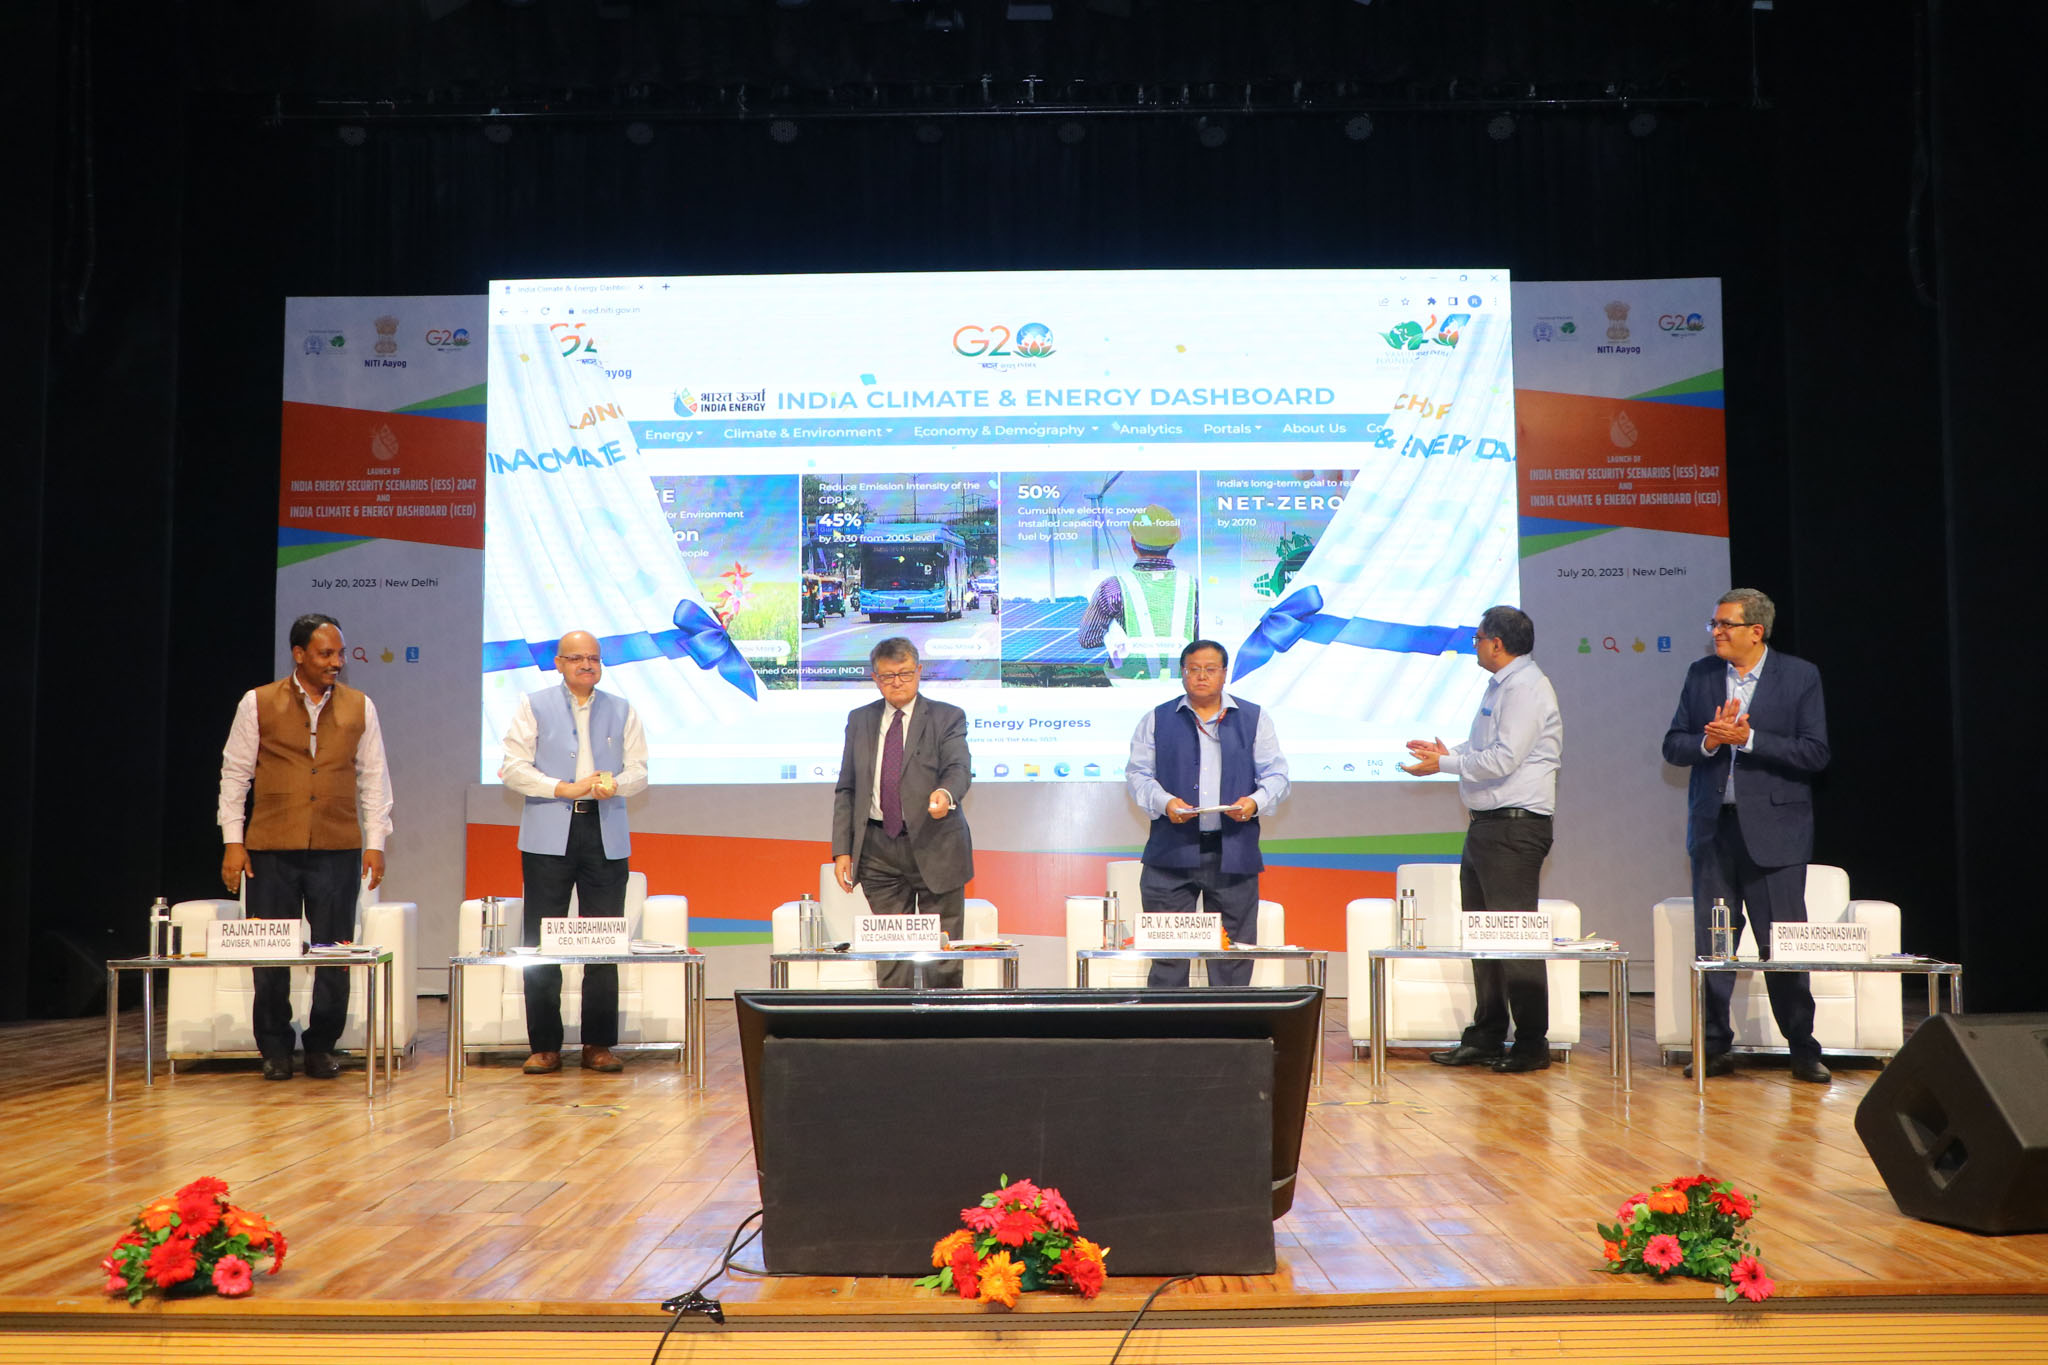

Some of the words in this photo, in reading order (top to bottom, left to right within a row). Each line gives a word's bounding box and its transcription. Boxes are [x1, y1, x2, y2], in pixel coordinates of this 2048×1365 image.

[1597, 346, 1614, 354] NITI
[1616, 346, 1640, 354] Aayog
[364, 360, 380, 368] NITI
[382, 360, 407, 368] Aayog
[604, 369, 632, 380] ayog
[700, 392, 732, 402] भारत
[736, 388, 766, 402] ऊर्जा
[866, 390, 990, 410] CLIMATE
[999, 390, 1016, 406] &
[1026, 388, 1142, 407] ENERGY
[1150, 388, 1336, 406] DASHBOARD
[701, 404, 727, 412] INDIA
[729, 402, 766, 412] ENERGY
[645, 429, 694, 442] Energy
[724, 428, 779, 439] Climate
[781, 428, 790, 438] &
[793, 427, 882, 438] Environment
[914, 426, 978, 439] Economy
[982, 426, 991, 436] &
[995, 424, 1085, 438] Demography
[1120, 423, 1183, 436] Analytics
[1204, 423, 1252, 434] Portals
[1283, 423, 1326, 434] About
[1329, 424, 1347, 434] Us
[367, 468, 388, 476] LAUNCH
[1530, 468, 1552, 480] INDIA
[1554, 468, 1585, 480] ENERGY
[1588, 468, 1624, 480] SECURITY
[1626, 467, 1670, 478] SCENARIOS
[1673, 465, 1698, 480] (IESS)
[1700, 466, 1720, 478] 2047
[290, 480, 313, 492] INDIA
[315, 480, 346, 492] ENERGY
[346, 480, 384, 492] SECURITY
[386, 480, 428, 492] SCENARIOS
[431, 478, 454, 493] (IESS)
[457, 480, 476, 490] 2047
[818, 483, 856, 491] Reduce
[859, 482, 904, 491] Emission
[906, 482, 950, 492] Intensity
[951, 482, 961, 490] of
[962, 482, 980, 490] the
[1217, 480, 1249, 488] India's
[1250, 480, 1300, 488] long-term
[1303, 480, 1325, 488] goal
[1618, 482, 1632, 490] AND
[1018, 485, 1060, 499] 50%
[376, 494, 390, 502] AND
[818, 496, 842, 504] GDP
[844, 496, 856, 506] by
[1218, 496, 1344, 511] NET-ZERO
[1530, 495, 1554, 507] INDIA
[1557, 494, 1593, 506] CLIMATE
[1604, 494, 1637, 505] ENERGY
[1640, 492, 1692, 504] DASHBOARD
[1694, 490, 1721, 507] (ICED)
[290, 506, 313, 518] INDIA
[316, 506, 350, 518] CLIMATE
[362, 506, 393, 517] ENERGY
[396, 505, 447, 516] DASHBOARD
[450, 504, 476, 519] (ICED)
[1018, 506, 1074, 515] Cumulative
[1076, 506, 1114, 514] electric
[1116, 507, 1148, 516] power
[818, 513, 862, 528] 45%
[1018, 520, 1060, 528] Installed
[1062, 520, 1104, 529] capacity
[1218, 518, 1230, 528] by
[1232, 518, 1256, 526] 2070
[818, 535, 832, 544] by
[834, 535, 858, 543] 2030
[860, 534, 884, 542] from
[886, 534, 912, 542] 2005
[913, 534, 936, 542] level
[1018, 532, 1036, 541] fuel
[1040, 532, 1052, 542] by
[1053, 532, 1078, 540] 2030
[1557, 568, 1579, 580] July
[1582, 568, 1597, 578] 20,
[1600, 568, 1624, 577] 2023
[1632, 568, 1656, 576] New
[1659, 566, 1687, 576] Delhi
[312, 578, 332, 590] July
[335, 579, 350, 588] 20,
[352, 578, 376, 588] 2023
[385, 578, 408, 588] New
[411, 578, 438, 588] Delhi
[752, 666, 778, 674] mined
[781, 666, 836, 674] Contribution
[839, 665, 865, 676] (NDC)
[974, 718, 1024, 730] Energy
[1029, 718, 1092, 730] Progress
[862, 919, 902, 932] SUMAN
[906, 918, 936, 931] BERY
[1142, 916, 1154, 928] DR.
[1156, 916, 1163, 928] V.
[1164, 916, 1172, 928] K.
[1174, 916, 1216, 928] SARASWAT
[1468, 916, 1483, 928] DR.
[1486, 916, 1520, 928] SUNEET
[1522, 916, 1549, 928] SINGH
[222, 923, 266, 936] RAJNATH
[270, 923, 290, 936] RAM
[547, 922, 566, 934] B.V.R.
[568, 922, 626, 934] SUBRAHMANYAM
[1778, 926, 1809, 940] SRINIVAS
[1811, 927, 1867, 940] KRISHNASWAMY
[576, 936, 590, 945] NITI
[591, 936, 616, 944] AAYOG
[1176, 932, 1188, 940] NITI
[1190, 932, 1211, 940] AAYOG
[221, 940, 252, 948] ADVISER,
[267, 939, 291, 947] AAYOG
[1796, 943, 1825, 951] VASUDHA
[1826, 943, 1866, 952] FOUNDATION
